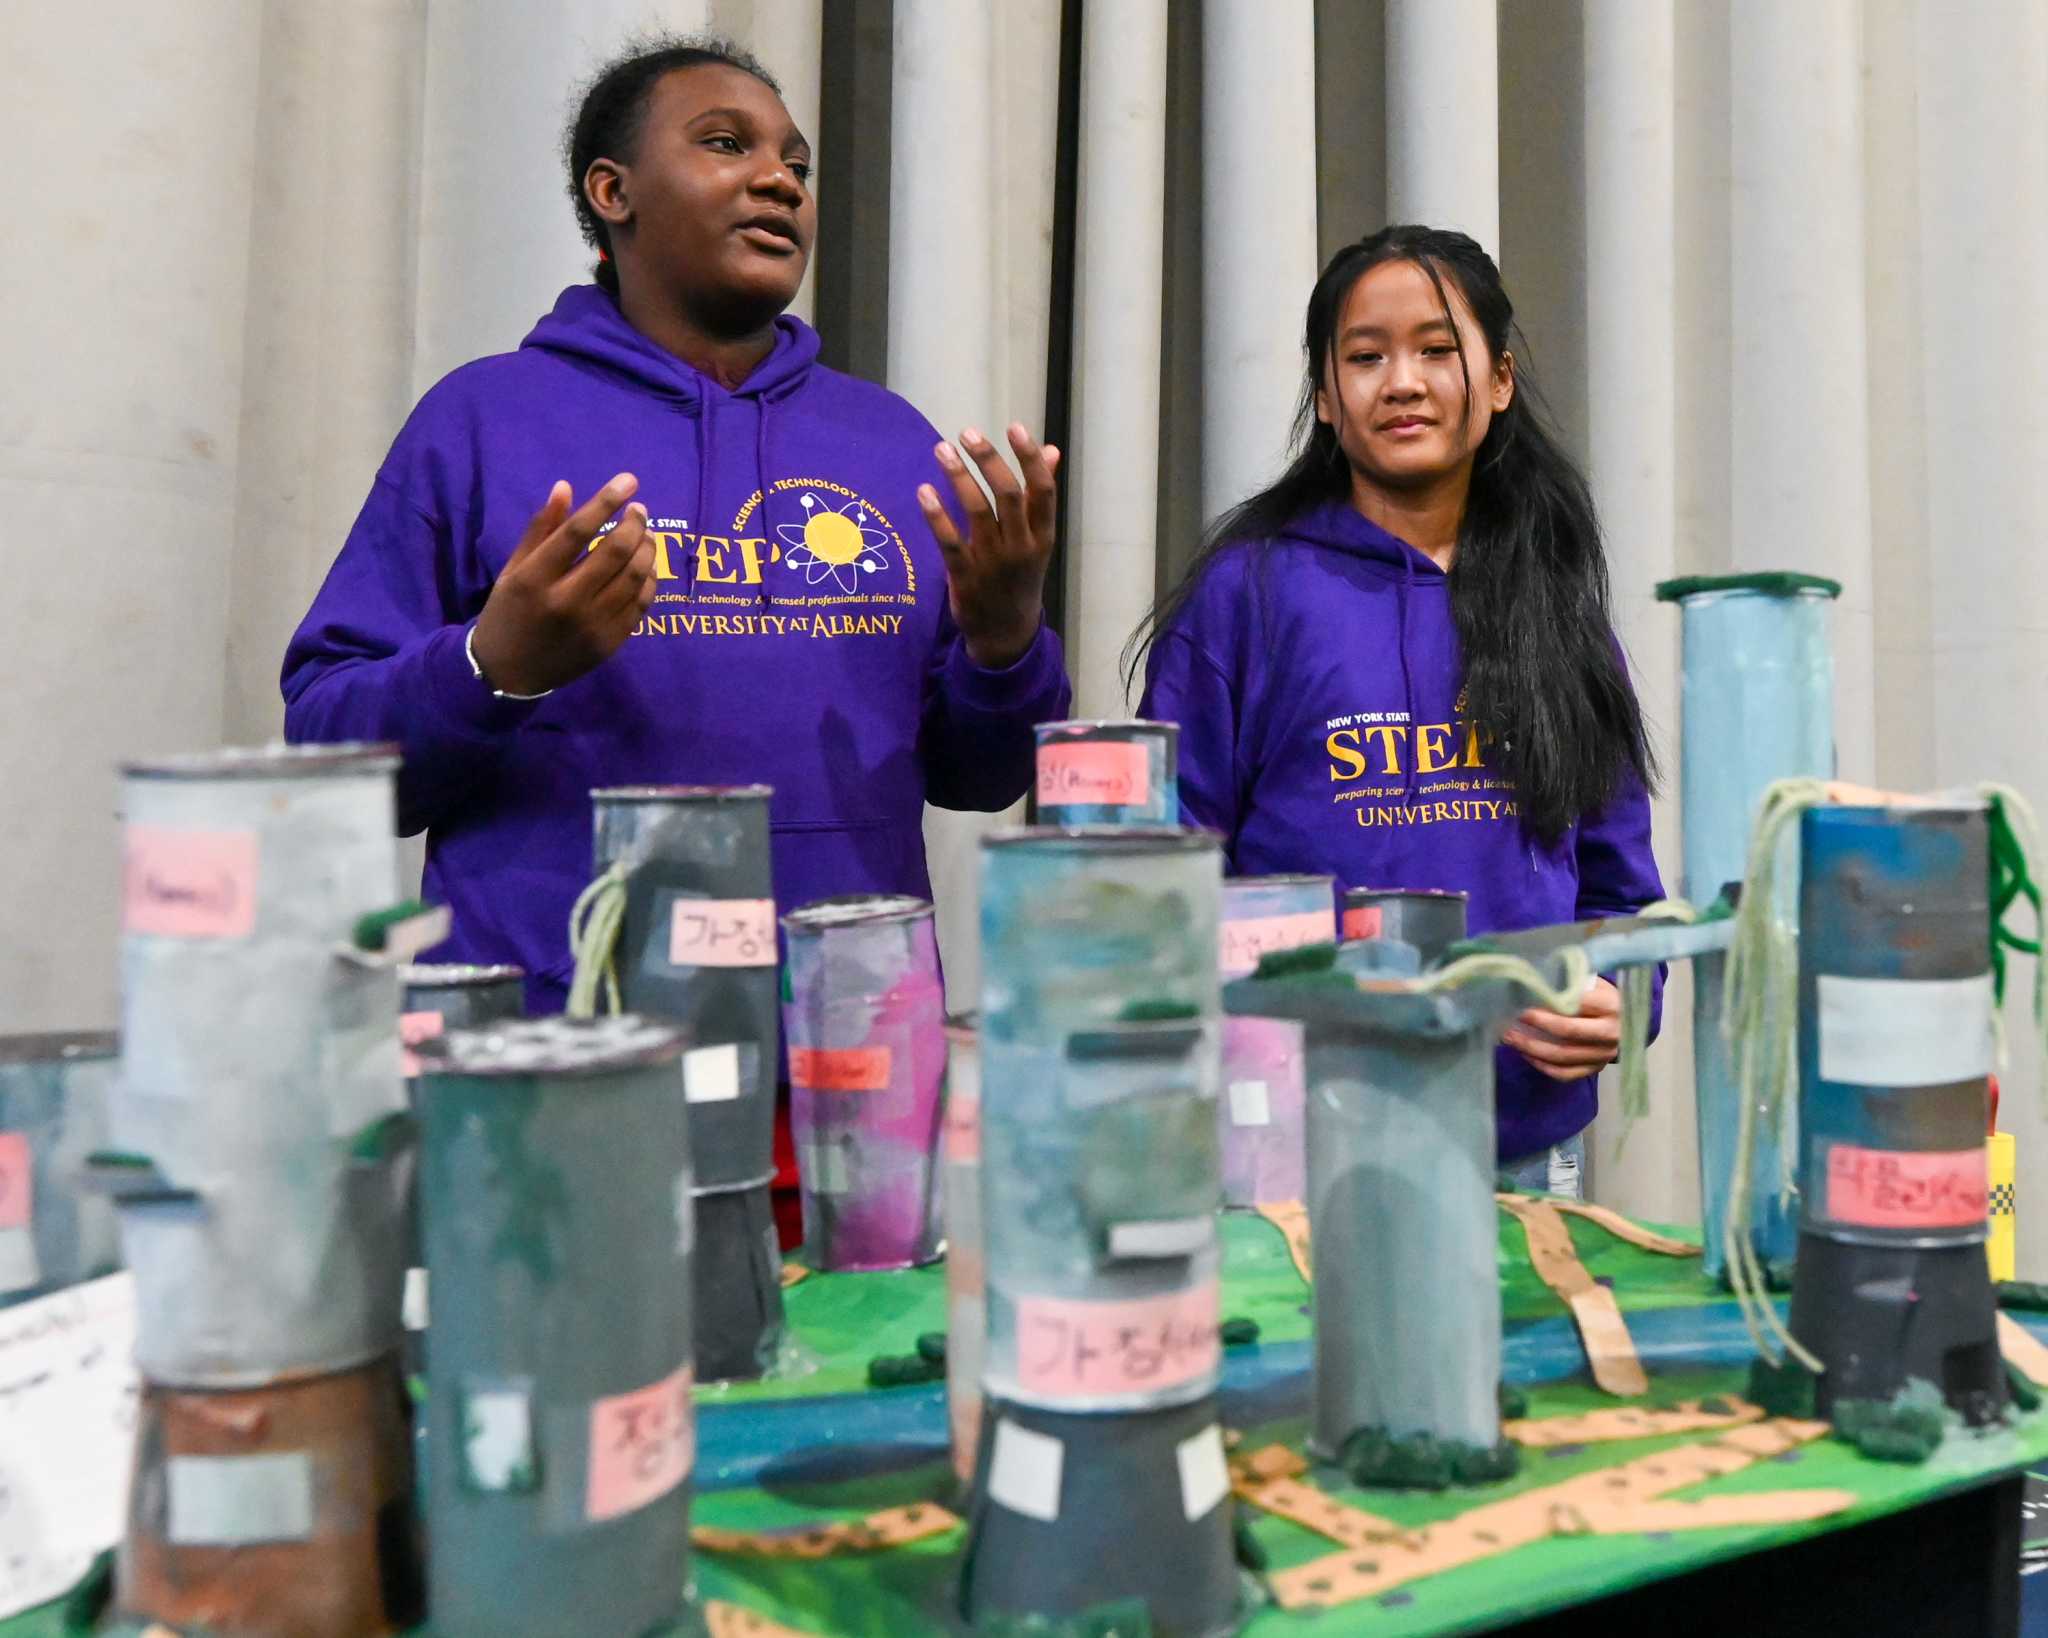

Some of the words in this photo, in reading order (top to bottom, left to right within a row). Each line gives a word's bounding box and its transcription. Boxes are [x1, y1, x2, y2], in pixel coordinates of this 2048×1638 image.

[657, 518, 689, 530] STATE
[774, 479, 858, 500] TECHNOLOGY
[860, 499, 893, 529] ENTRY
[890, 531, 917, 592] PROGRAM
[588, 531, 782, 586] TEP
[698, 593, 752, 607] technology
[770, 594, 806, 606] icensed
[807, 593, 870, 608] professionals
[871, 593, 895, 604] since
[896, 592, 917, 607] 1986
[789, 617, 810, 632] AT
[810, 612, 904, 639] ALBANY
[1326, 715, 1352, 730] NEW
[1354, 712, 1384, 724] YORK
[1386, 712, 1411, 722] STATE
[1333, 786, 1383, 803] preparing
[1418, 779, 1470, 795] technology
[1472, 779, 1481, 790] &
[1355, 800, 1502, 828] UNIVERSITY
